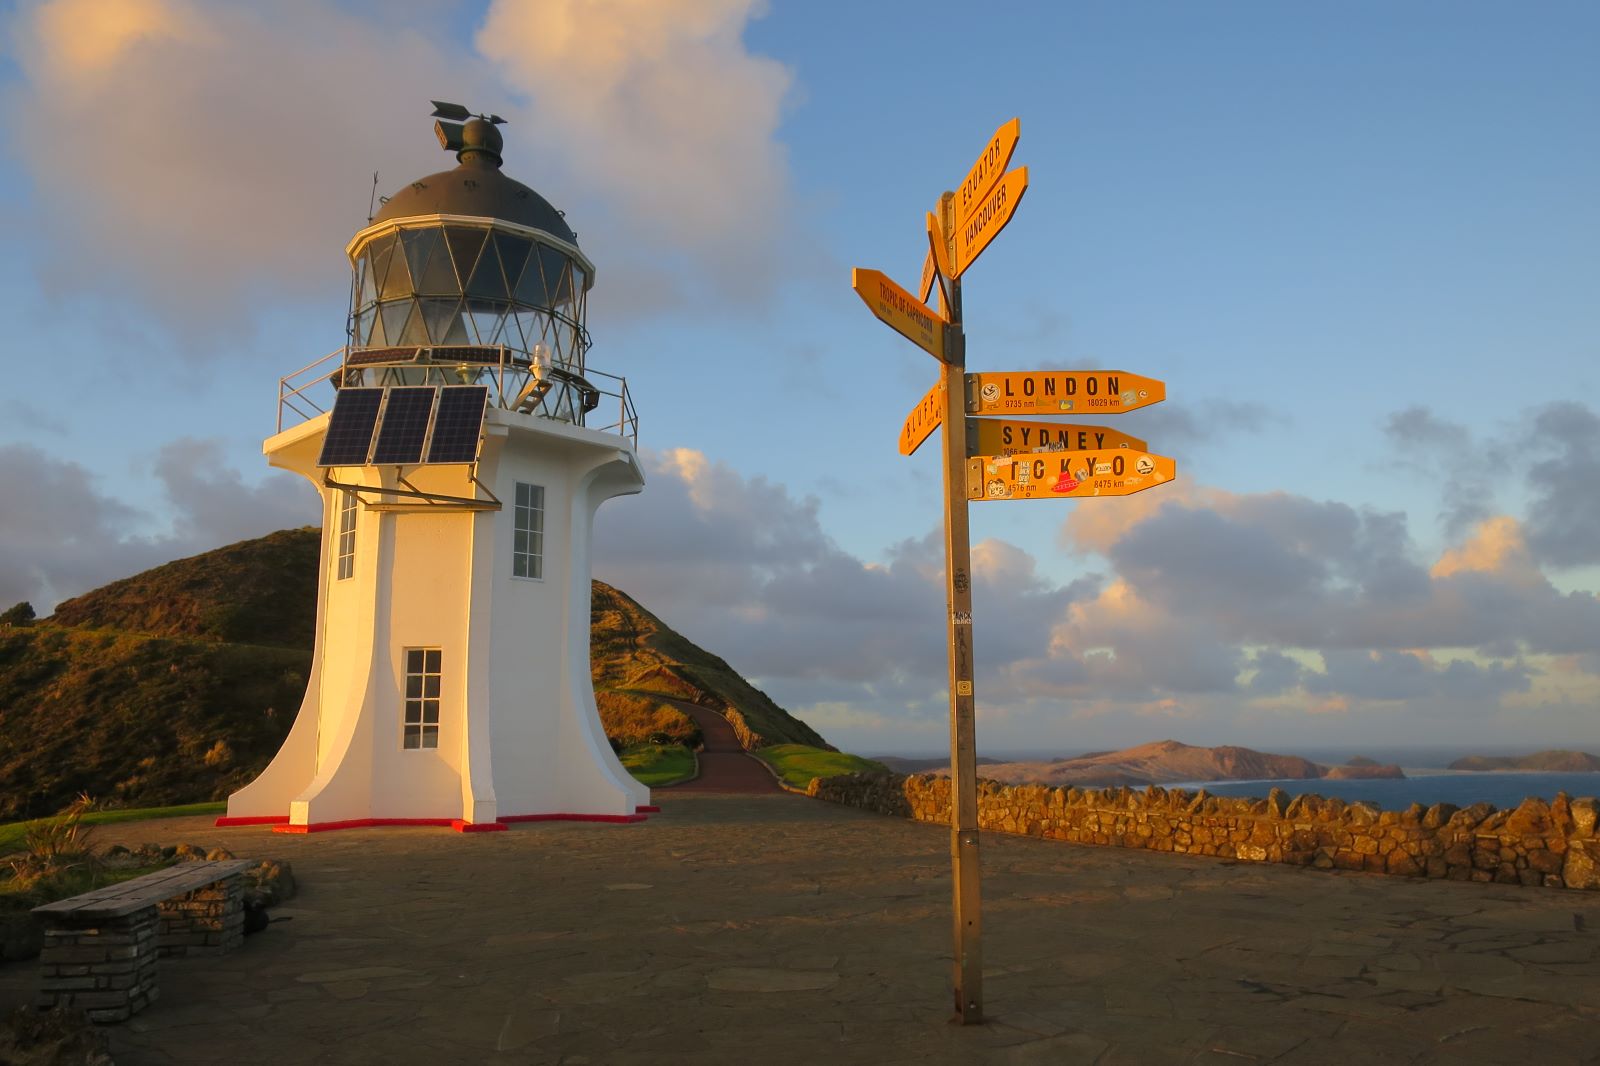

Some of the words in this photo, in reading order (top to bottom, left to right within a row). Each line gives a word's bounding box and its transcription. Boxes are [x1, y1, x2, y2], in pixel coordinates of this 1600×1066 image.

[963, 138, 1000, 206] EQUATOR
[965, 184, 1006, 247] VANCOUVER
[1005, 376, 1119, 397] LONDON
[1005, 399, 1022, 408] 9735
[1087, 398, 1108, 407] 18029
[1109, 398, 1120, 407] km
[1003, 426, 1105, 450] SYDNEY
[1008, 484, 1025, 492] 4576
[1027, 484, 1037, 492] nm
[1094, 479, 1111, 488] 8475
[1113, 478, 1125, 488] km
